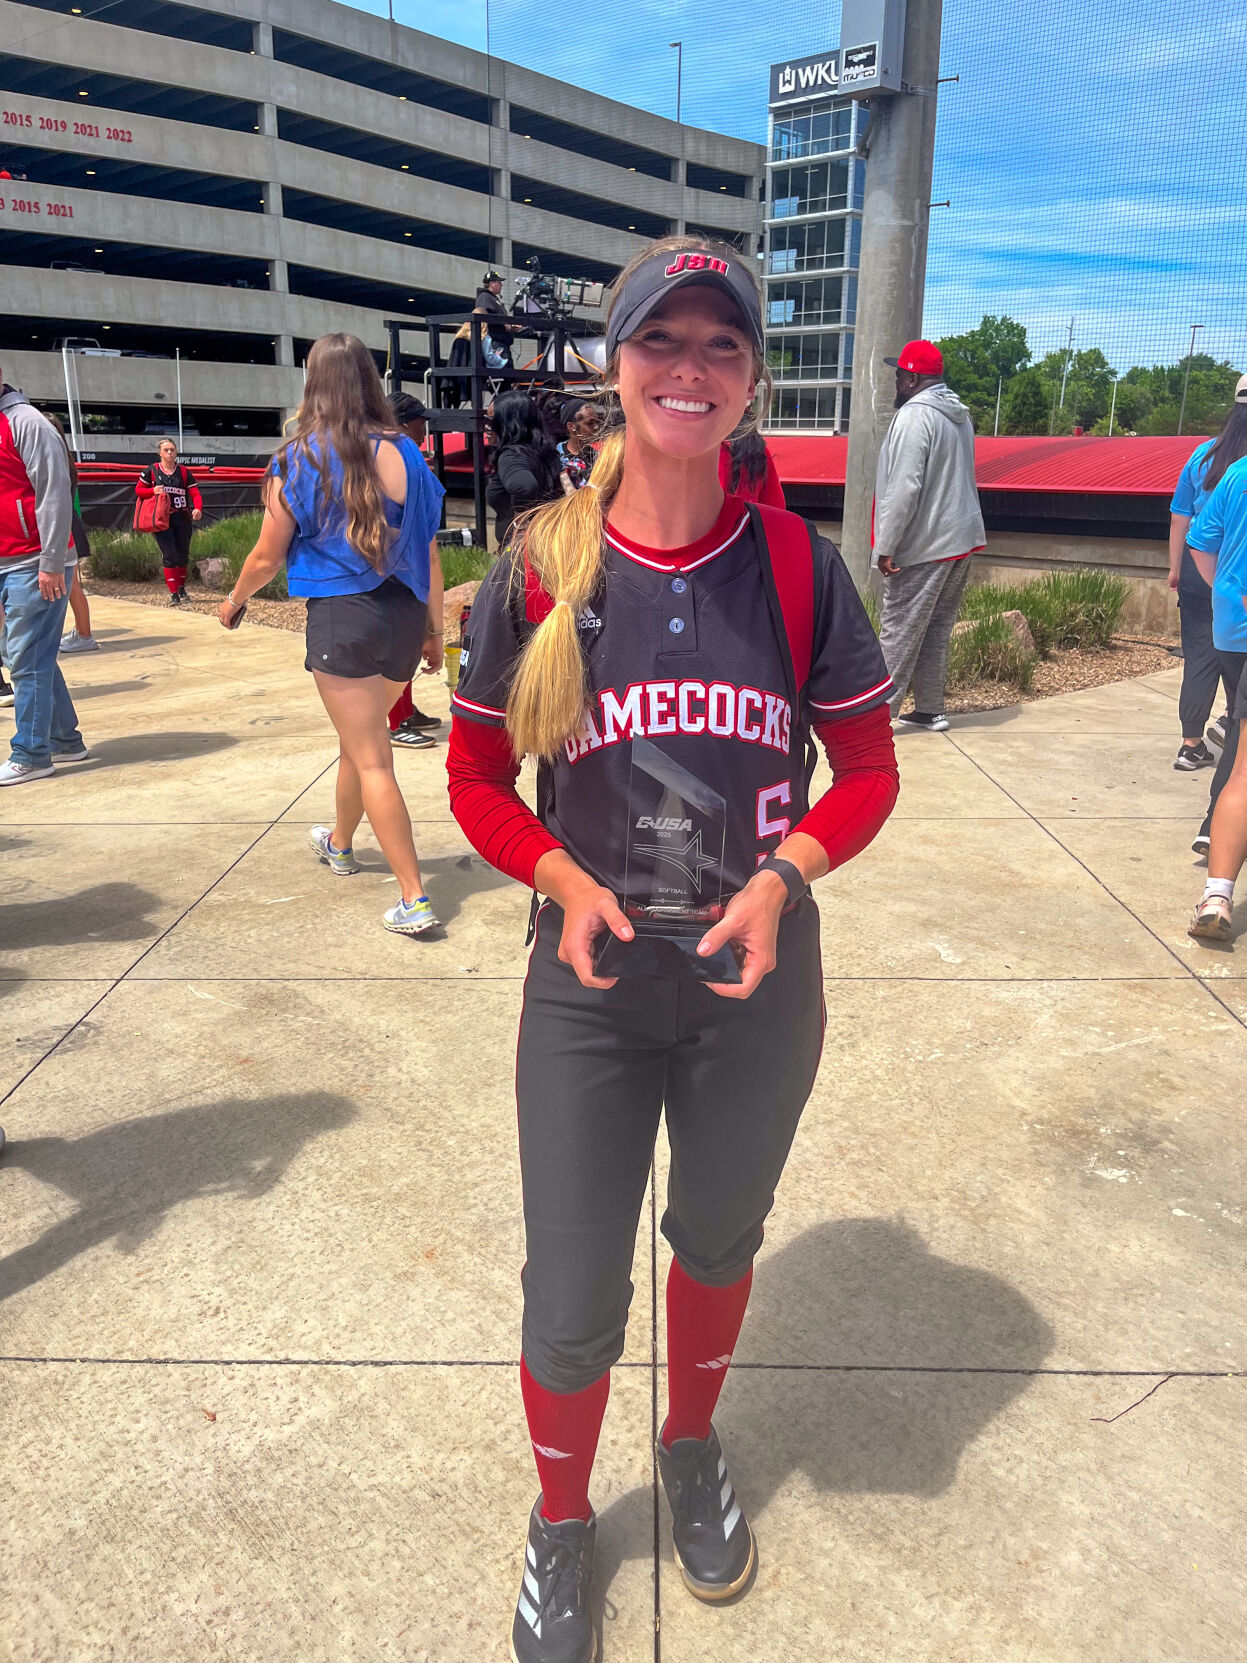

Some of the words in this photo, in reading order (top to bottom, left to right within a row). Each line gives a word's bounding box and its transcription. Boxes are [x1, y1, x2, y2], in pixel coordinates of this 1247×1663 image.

[2, 111, 33, 128] 2015
[38, 117, 67, 132] 2019
[73, 122, 100, 138] 2021
[106, 127, 133, 143] 2022
[11, 199, 41, 214] 2015
[46, 203, 74, 218] 2021
[665, 253, 729, 278] JSU
[191, 456, 216, 464] MEDALIST
[174, 496, 187, 508] 99
[658, 887, 688, 895] SOFTBALL
